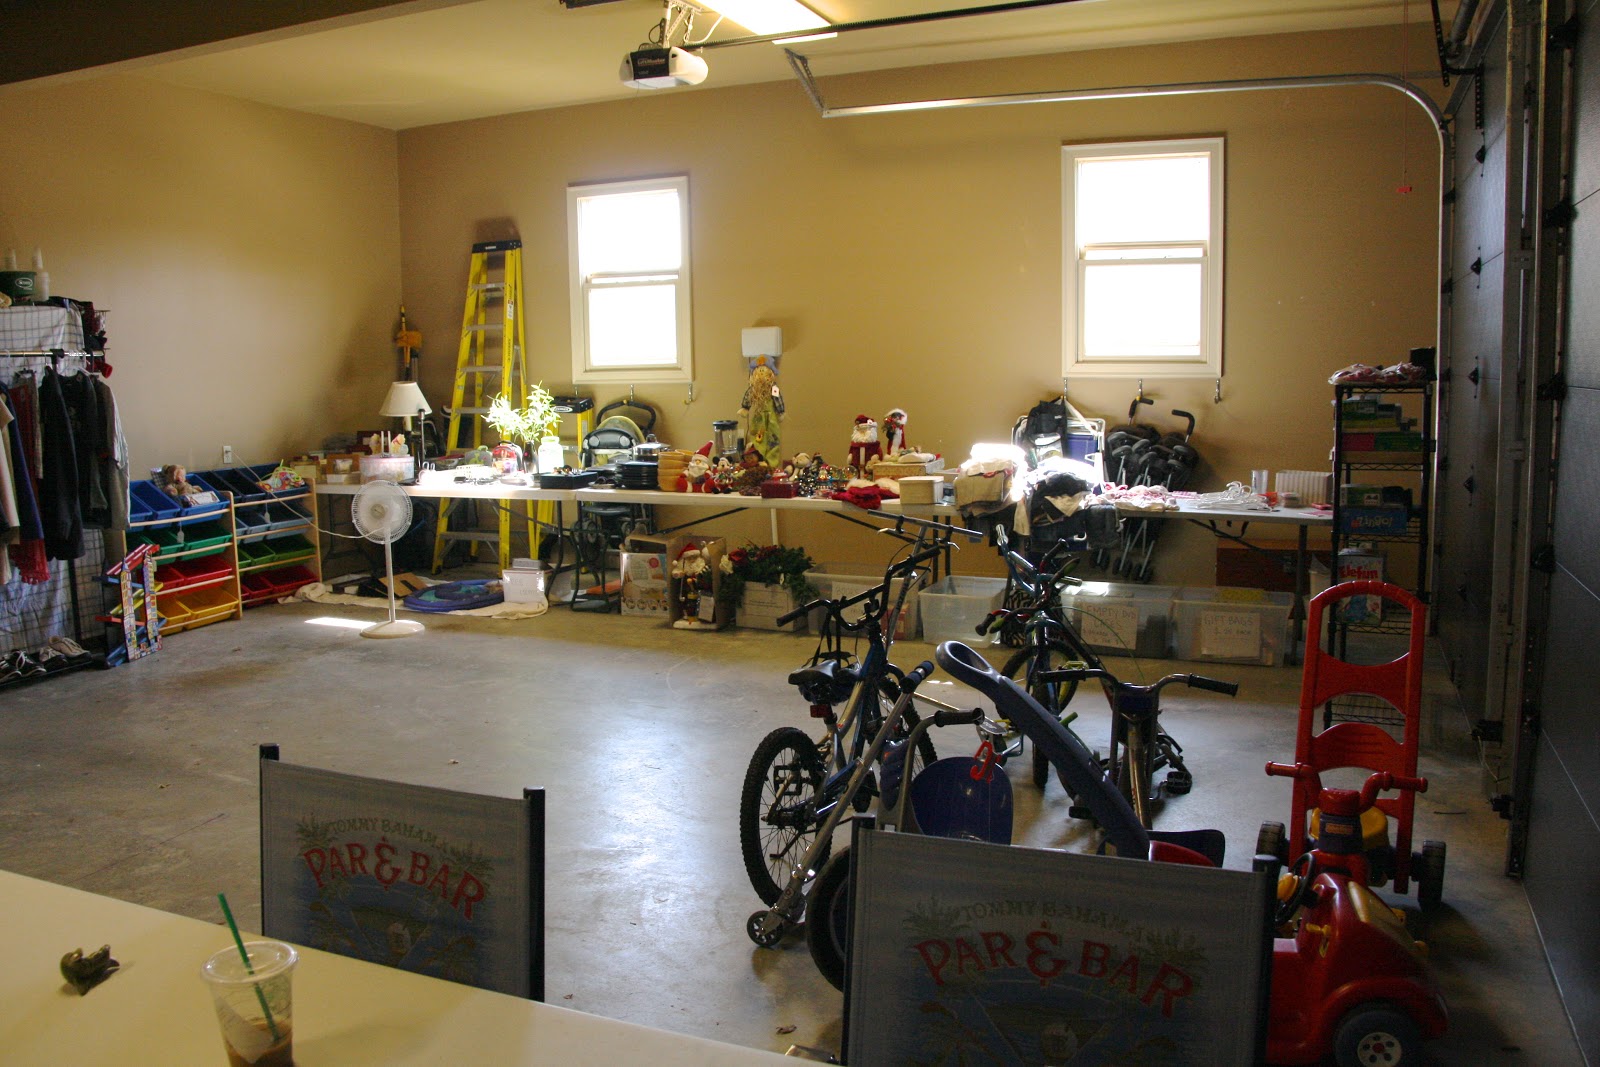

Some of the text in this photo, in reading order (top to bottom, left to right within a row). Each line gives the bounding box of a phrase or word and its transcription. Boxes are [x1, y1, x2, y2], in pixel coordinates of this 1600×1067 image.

[328, 817, 379, 833] TOMMY
[303, 842, 369, 889] PAR
[408, 850, 486, 921] BAR
[914, 931, 1018, 987] PAR
[1078, 939, 1194, 1019] BAR
